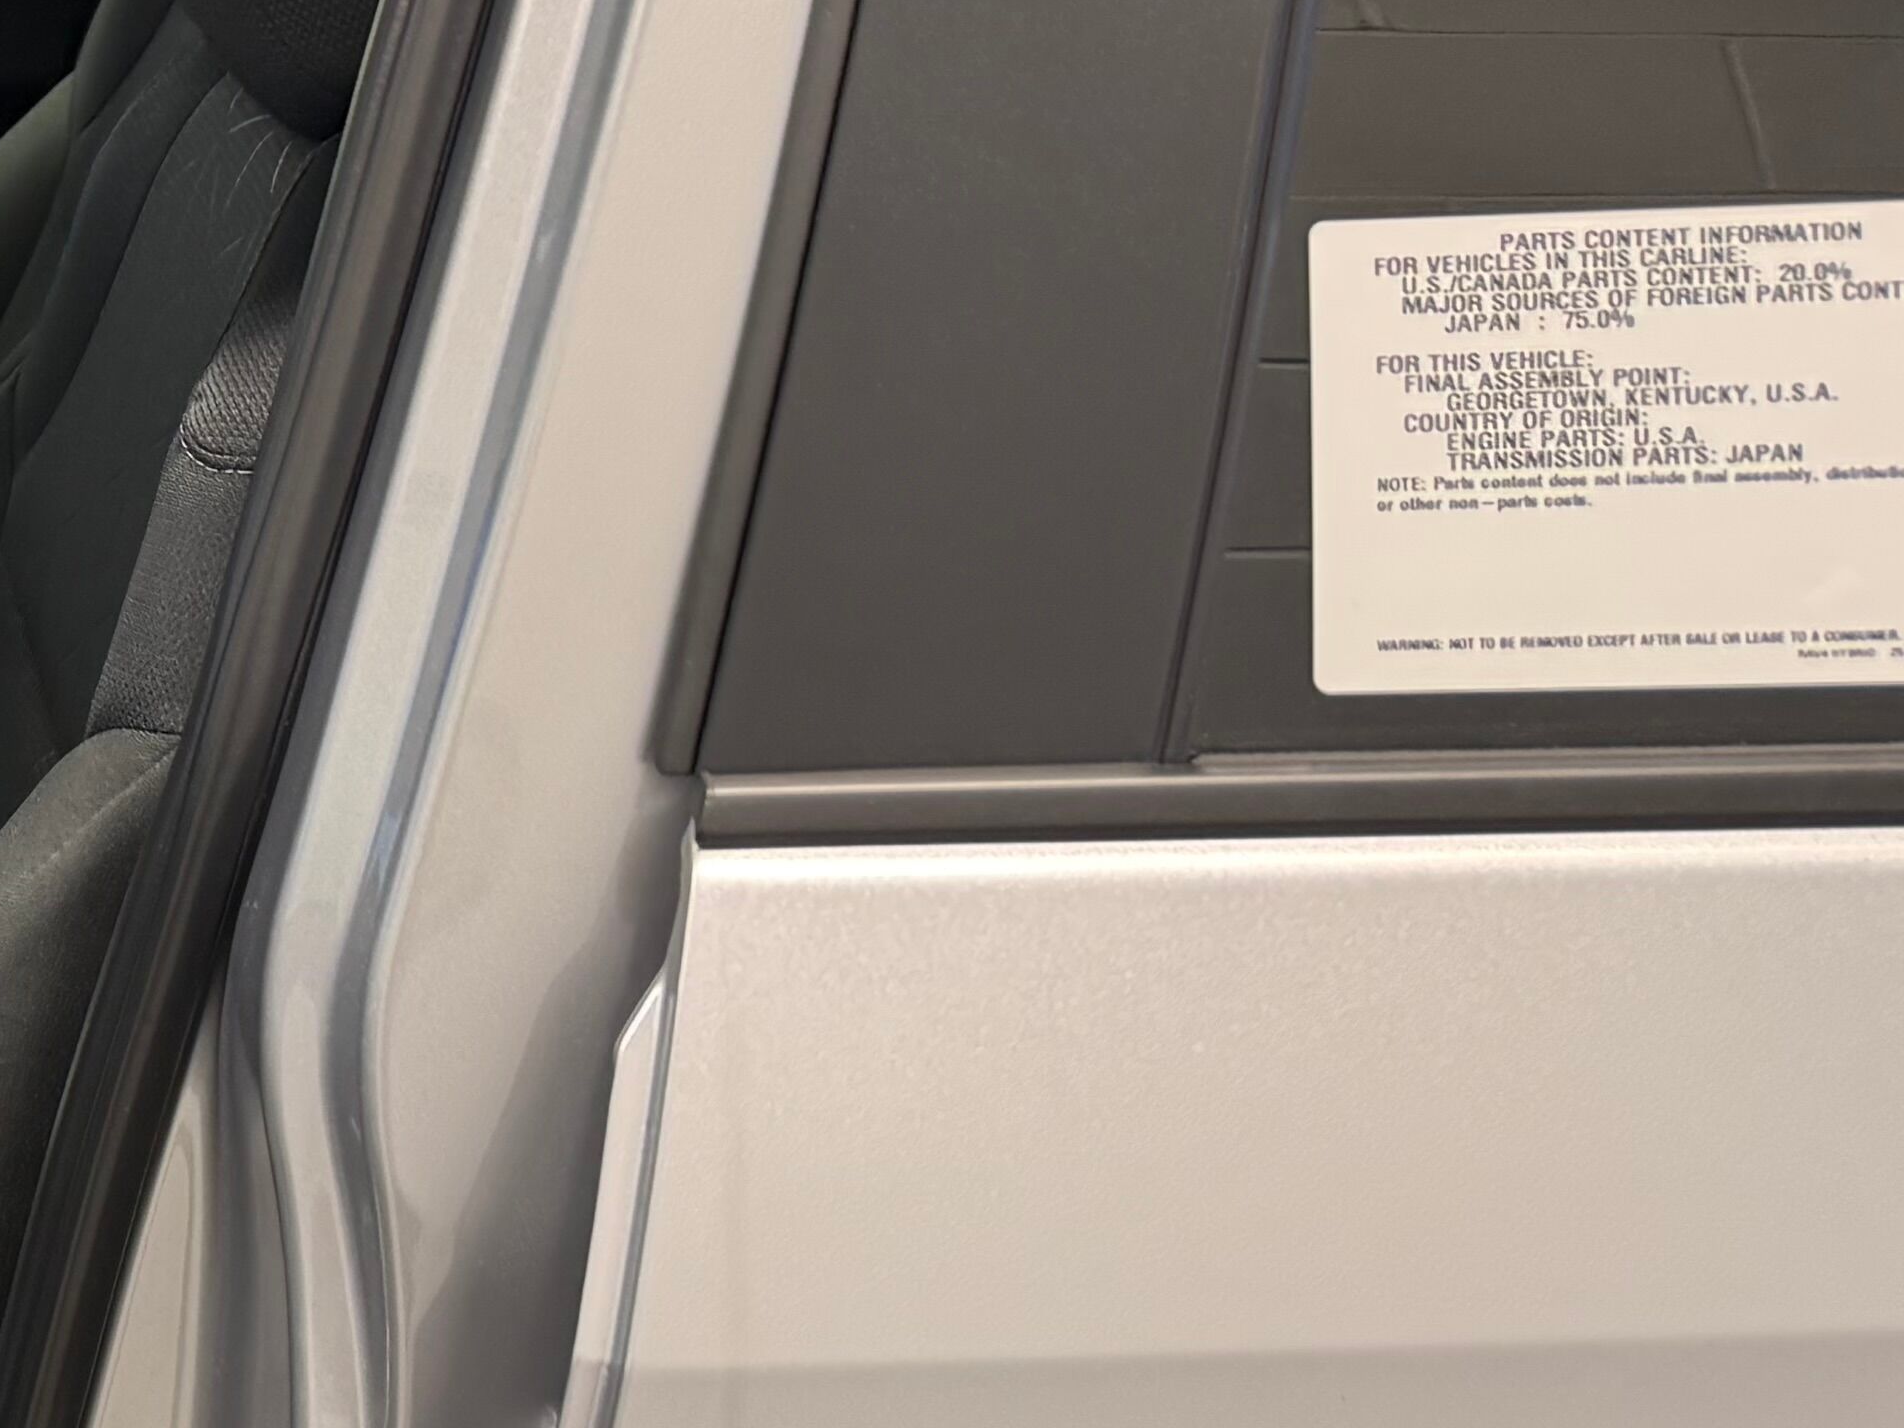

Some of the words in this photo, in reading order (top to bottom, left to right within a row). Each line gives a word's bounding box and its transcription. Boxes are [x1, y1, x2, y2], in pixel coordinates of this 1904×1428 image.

[1500, 231, 1576, 252] PARTS
[1585, 227, 1690, 250] CONTENT
[1700, 222, 1862, 246] INFORMATION
[1375, 255, 1418, 275] FOR
[1426, 252, 1537, 274] VEHICLES
[1546, 251, 1568, 271] IN
[1578, 249, 1631, 270] THIS
[1640, 246, 1747, 268] CARLINE:
[1402, 271, 1553, 295] U.S./CANADA
[1562, 269, 1638, 290] PARTS
[1647, 265, 1761, 288] CONTENT:
[1779, 262, 1852, 283] 20.0%
[1402, 293, 1482, 314] MAJOR
[1492, 289, 1599, 311] SOURCES
[1608, 288, 1637, 308] OF
[1647, 285, 1746, 307] FOREIGN
[1756, 282, 1833, 303] PARTS
[1445, 312, 1520, 333] JAPAN
[1563, 309, 1635, 330] 75.0%
[1376, 354, 1420, 374] FOR
[1428, 352, 1481, 372] THIS
[1490, 350, 1593, 371] VEHICLE:
[1405, 373, 1470, 394] FINAL
[1478, 369, 1604, 392] ASSEMBLY
[1613, 366, 1690, 387] POINT:
[1447, 388, 1614, 411] GEORGETOWN,
[1625, 385, 1757, 407] KENTUCKY,
[1766, 383, 1838, 403] U.S.A.
[1404, 411, 1513, 432] COUNTRY
[1523, 410, 1552, 429] OF
[1560, 407, 1648, 429] ORIGIN:
[1447, 430, 1531, 451] ENGINE
[1541, 428, 1624, 448] PARTS:
[1634, 426, 1705, 446] U.S.A.
[1447, 448, 1623, 471] TRANSMISSION
[1633, 445, 1717, 466] PARTS:
[1726, 443, 1803, 464] JAPAN
[1434, 474, 1475, 491] Parts
[1480, 472, 1543, 490] content
[1549, 471, 1588, 488] does
[1594, 471, 1620, 487] not
[1626, 469, 1686, 487] include
[1377, 497, 1393, 513] or
[1400, 496, 1442, 512] other
